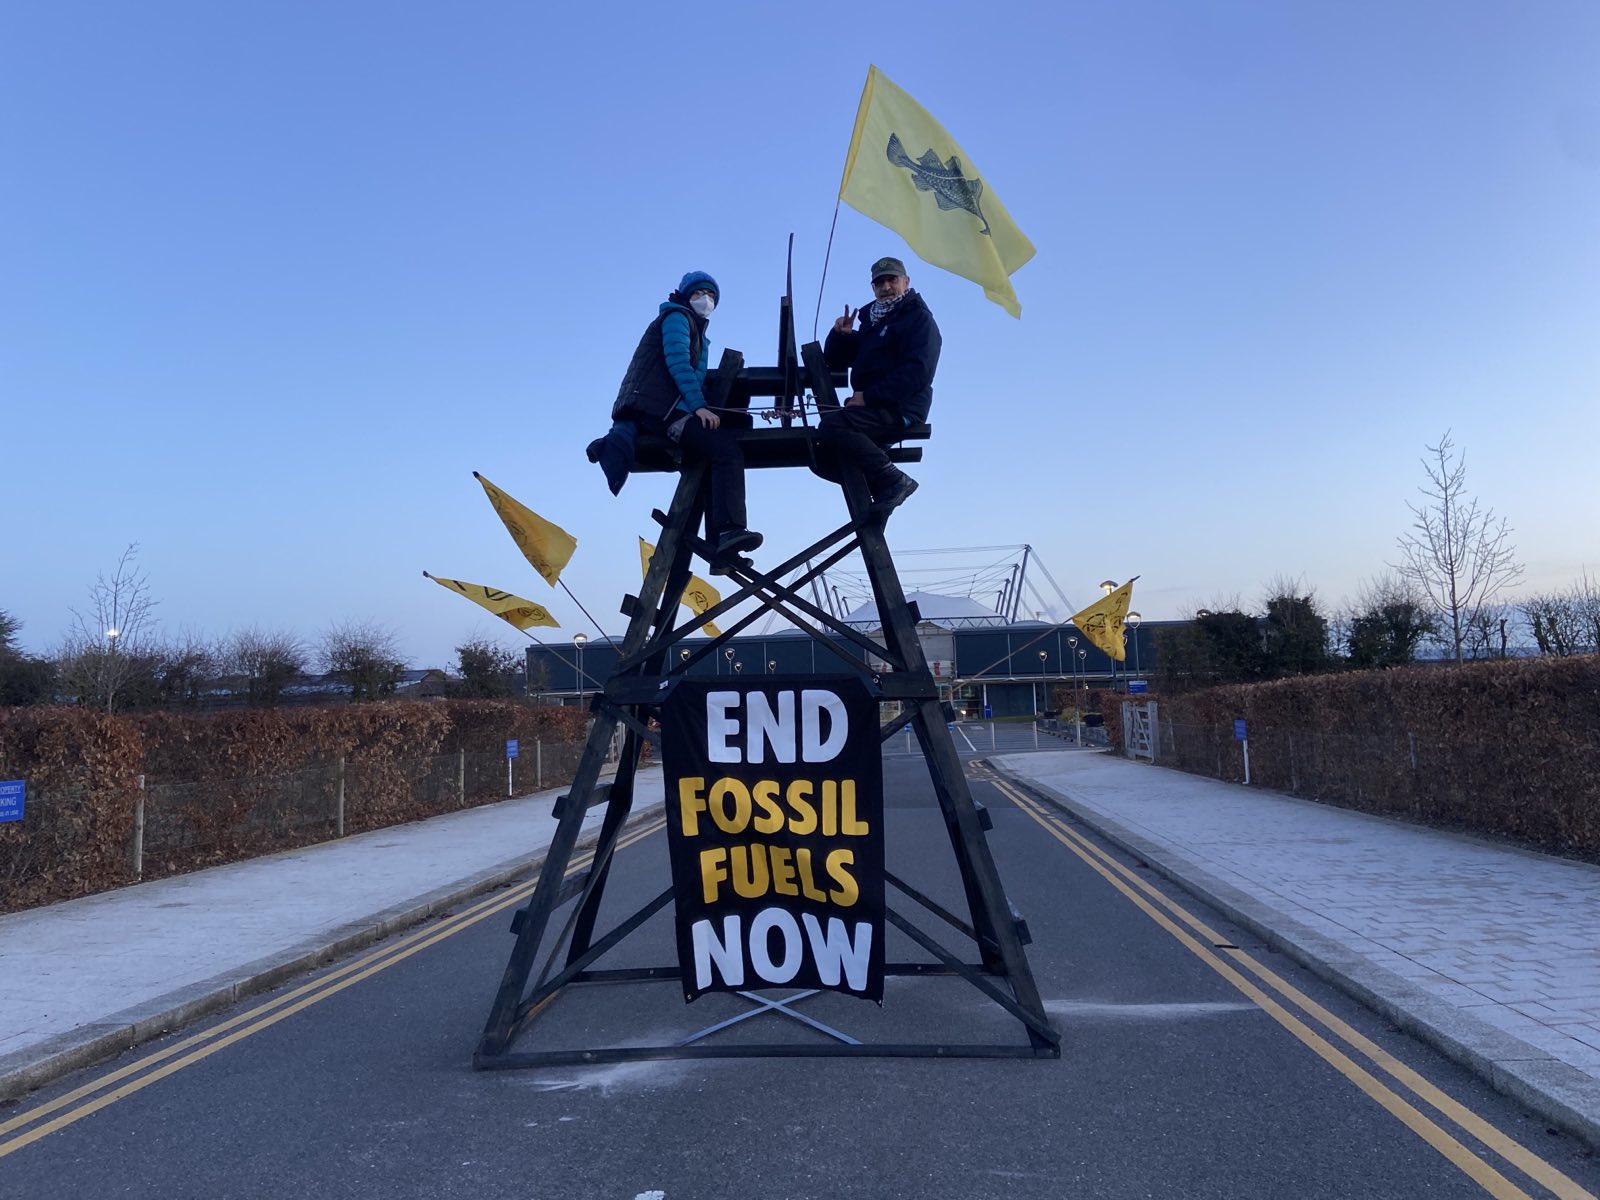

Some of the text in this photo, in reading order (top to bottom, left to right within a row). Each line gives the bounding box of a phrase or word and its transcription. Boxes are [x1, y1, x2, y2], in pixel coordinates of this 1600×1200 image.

[707, 690, 848, 763] END
[678, 776, 869, 837] FOSSIL
[699, 843, 859, 907] FUELS
[691, 907, 873, 991] NOW
